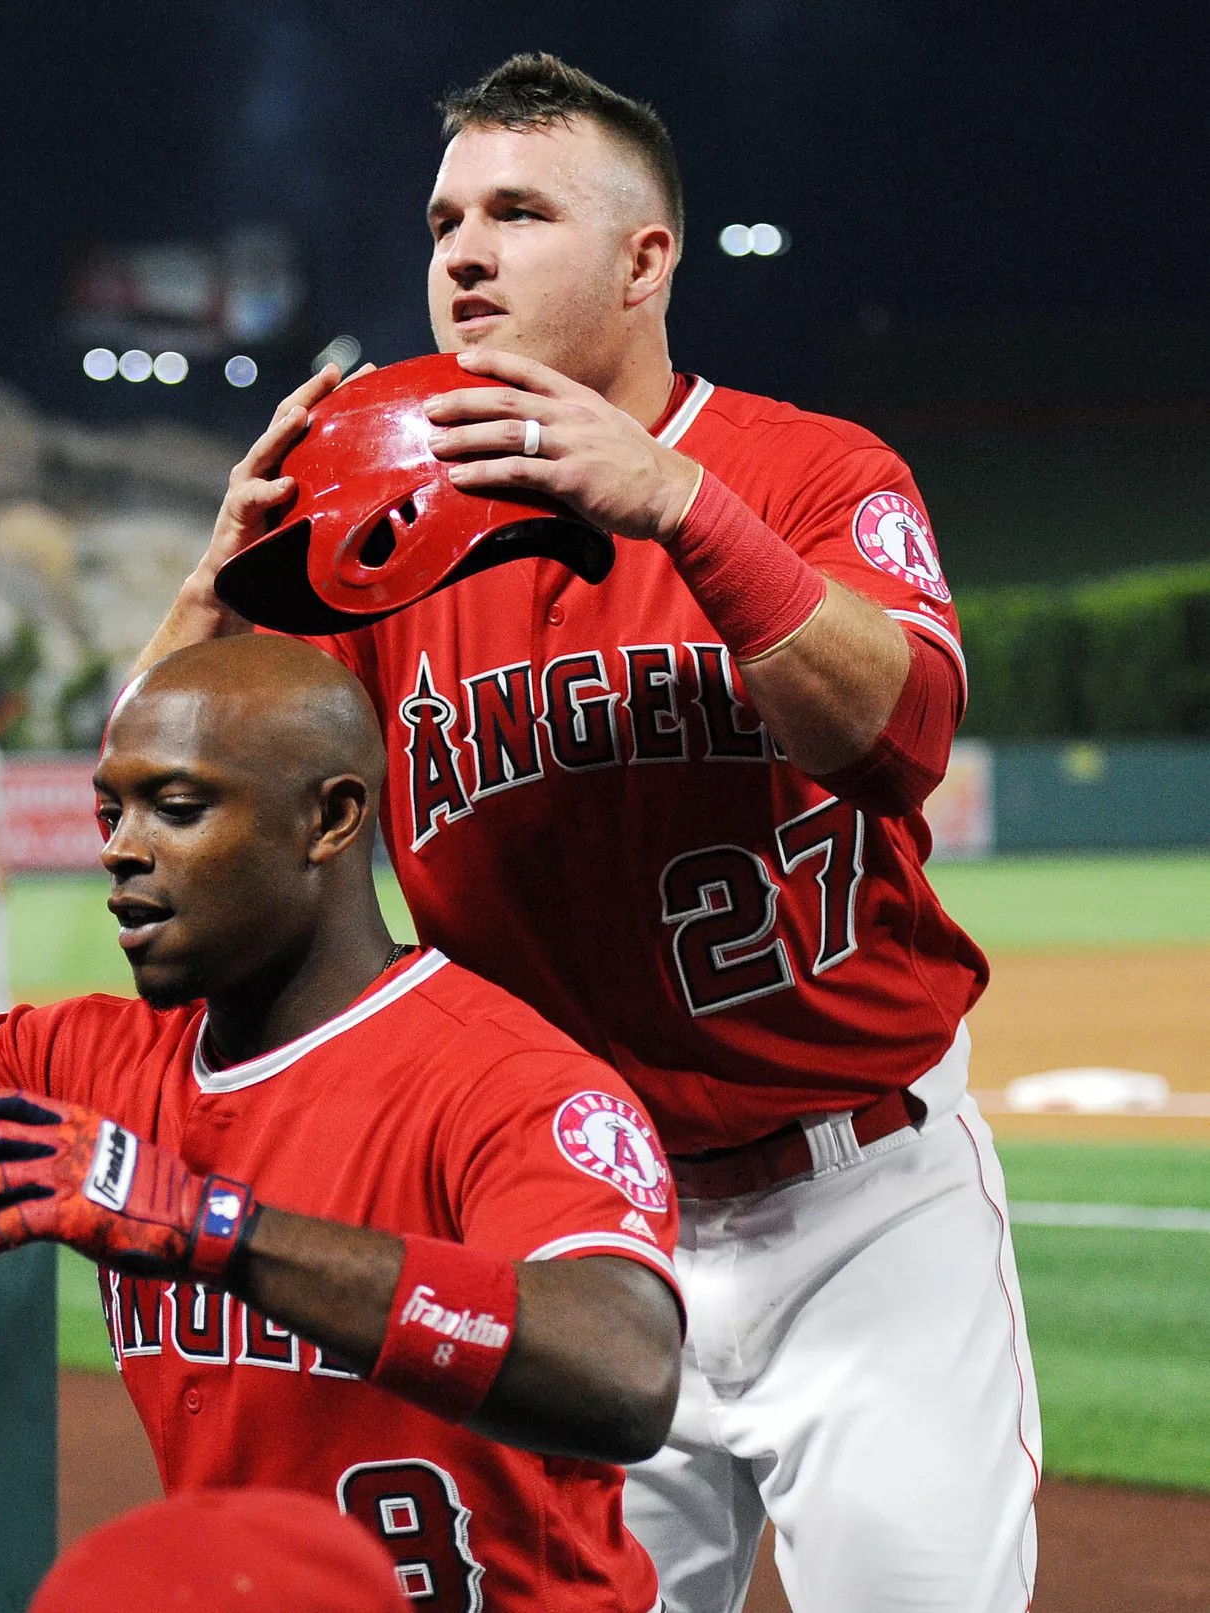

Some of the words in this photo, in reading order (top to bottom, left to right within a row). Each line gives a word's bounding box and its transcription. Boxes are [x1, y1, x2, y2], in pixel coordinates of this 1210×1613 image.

[868, 497, 928, 536] ANGELS
[399, 641, 788, 853] ANGEL
[658, 797, 864, 1016] 27
[572, 1095, 651, 1137] ANGELS
[433, 1342, 455, 1368] 8
